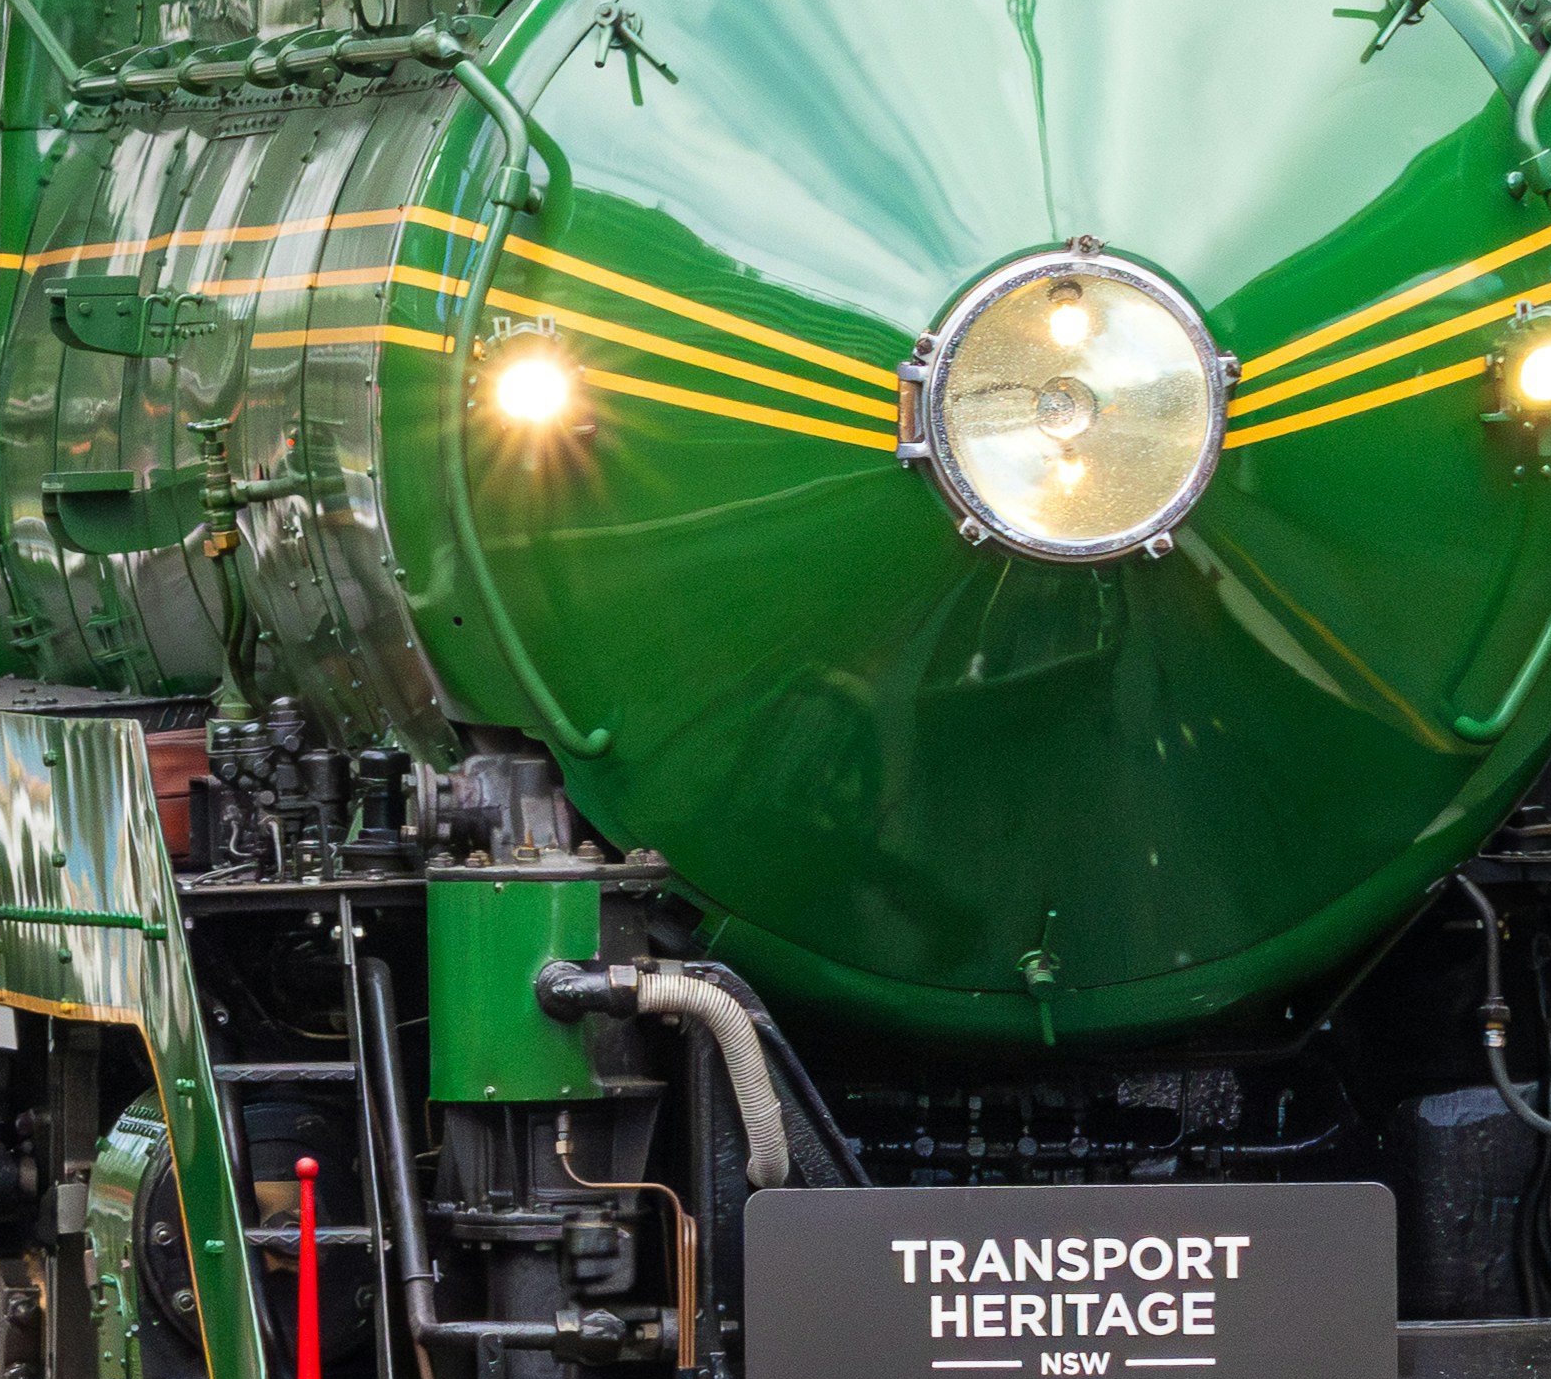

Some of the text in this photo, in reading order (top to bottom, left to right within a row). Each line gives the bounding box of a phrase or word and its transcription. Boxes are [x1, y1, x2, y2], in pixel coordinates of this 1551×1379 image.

[891, 1235, 1251, 1283] TRANSPORT
[930, 1291, 1216, 1338] HERITAGE
[1040, 1351, 1111, 1376] NSW
